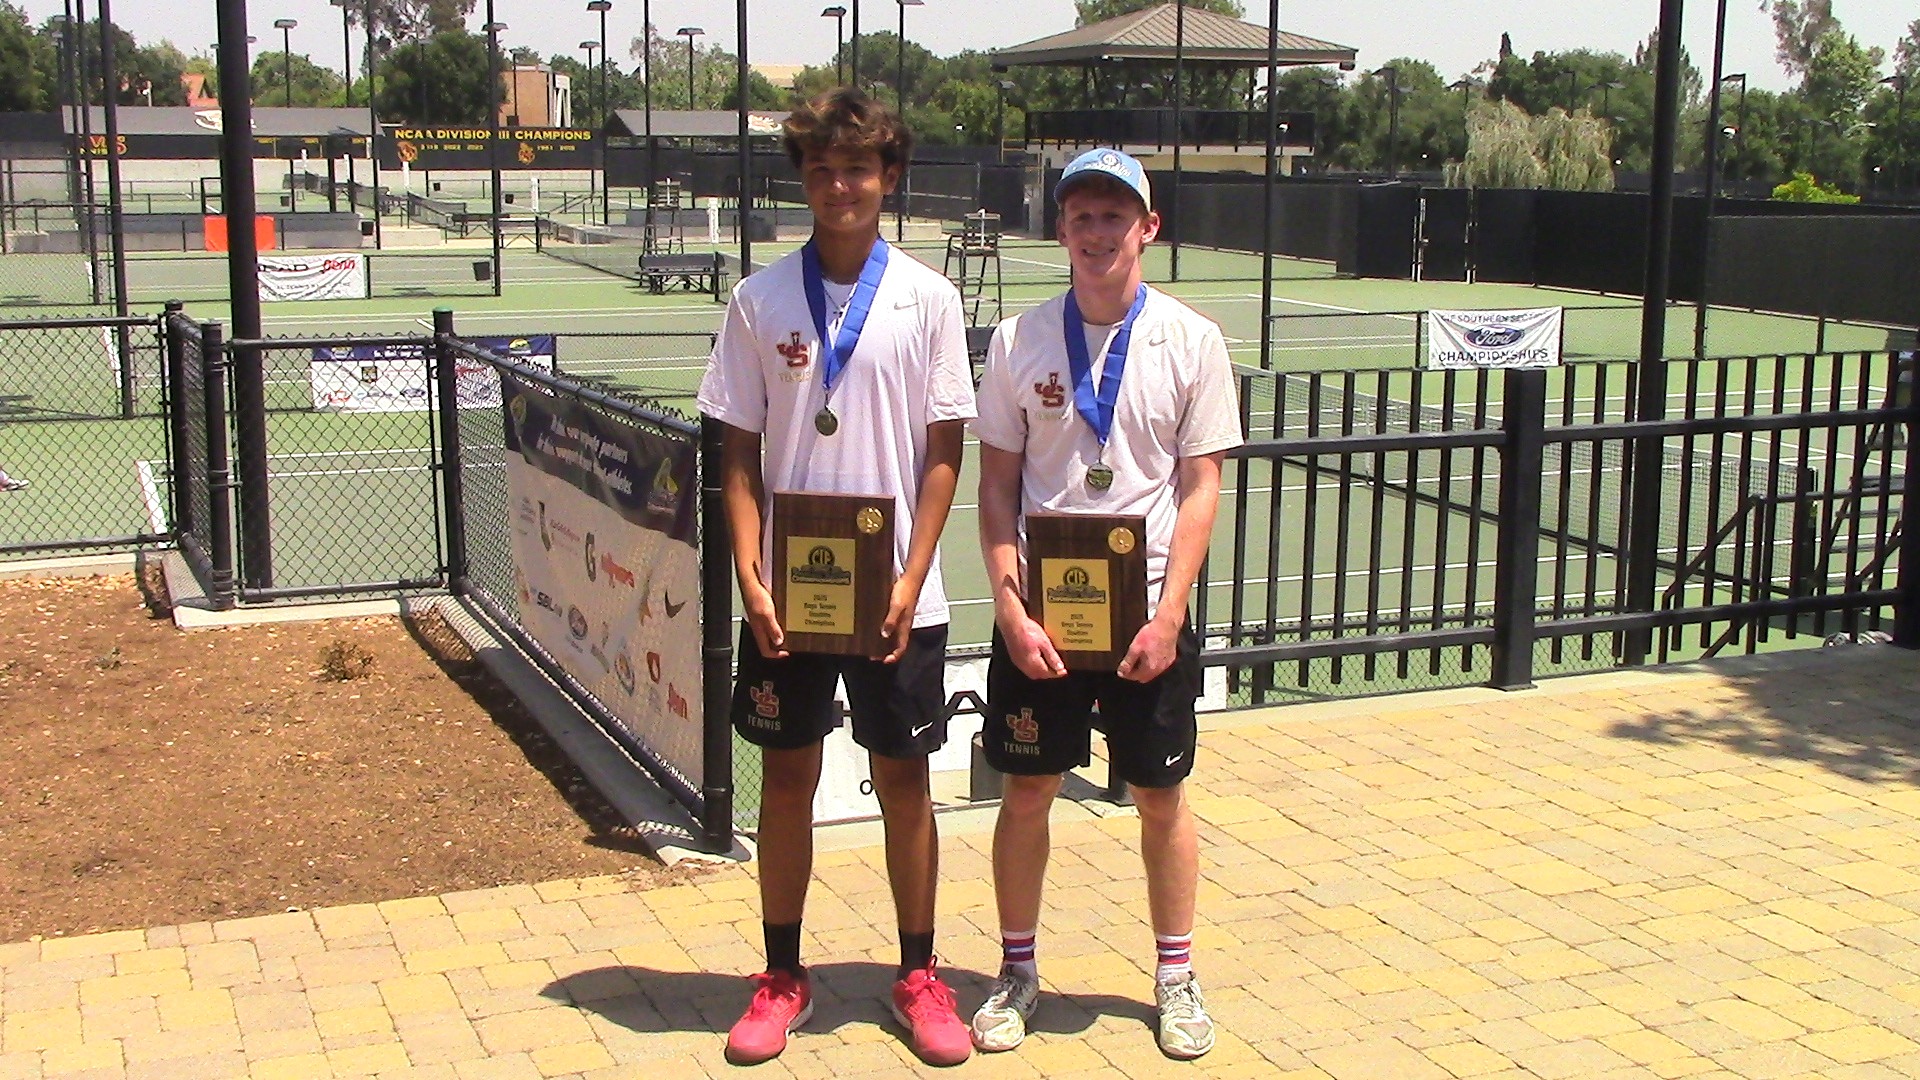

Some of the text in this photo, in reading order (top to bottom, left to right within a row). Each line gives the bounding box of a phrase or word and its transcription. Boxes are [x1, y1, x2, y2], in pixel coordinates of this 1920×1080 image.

[395, 129, 434, 139] NCAA
[514, 130, 591, 141] CHAMPIONS
[1475, 326, 1514, 348] Ford
[1438, 347, 1549, 363] CHAMPIONSHIPS
[747, 714, 782, 731] TENNIS
[1003, 741, 1040, 755] TENNIS
